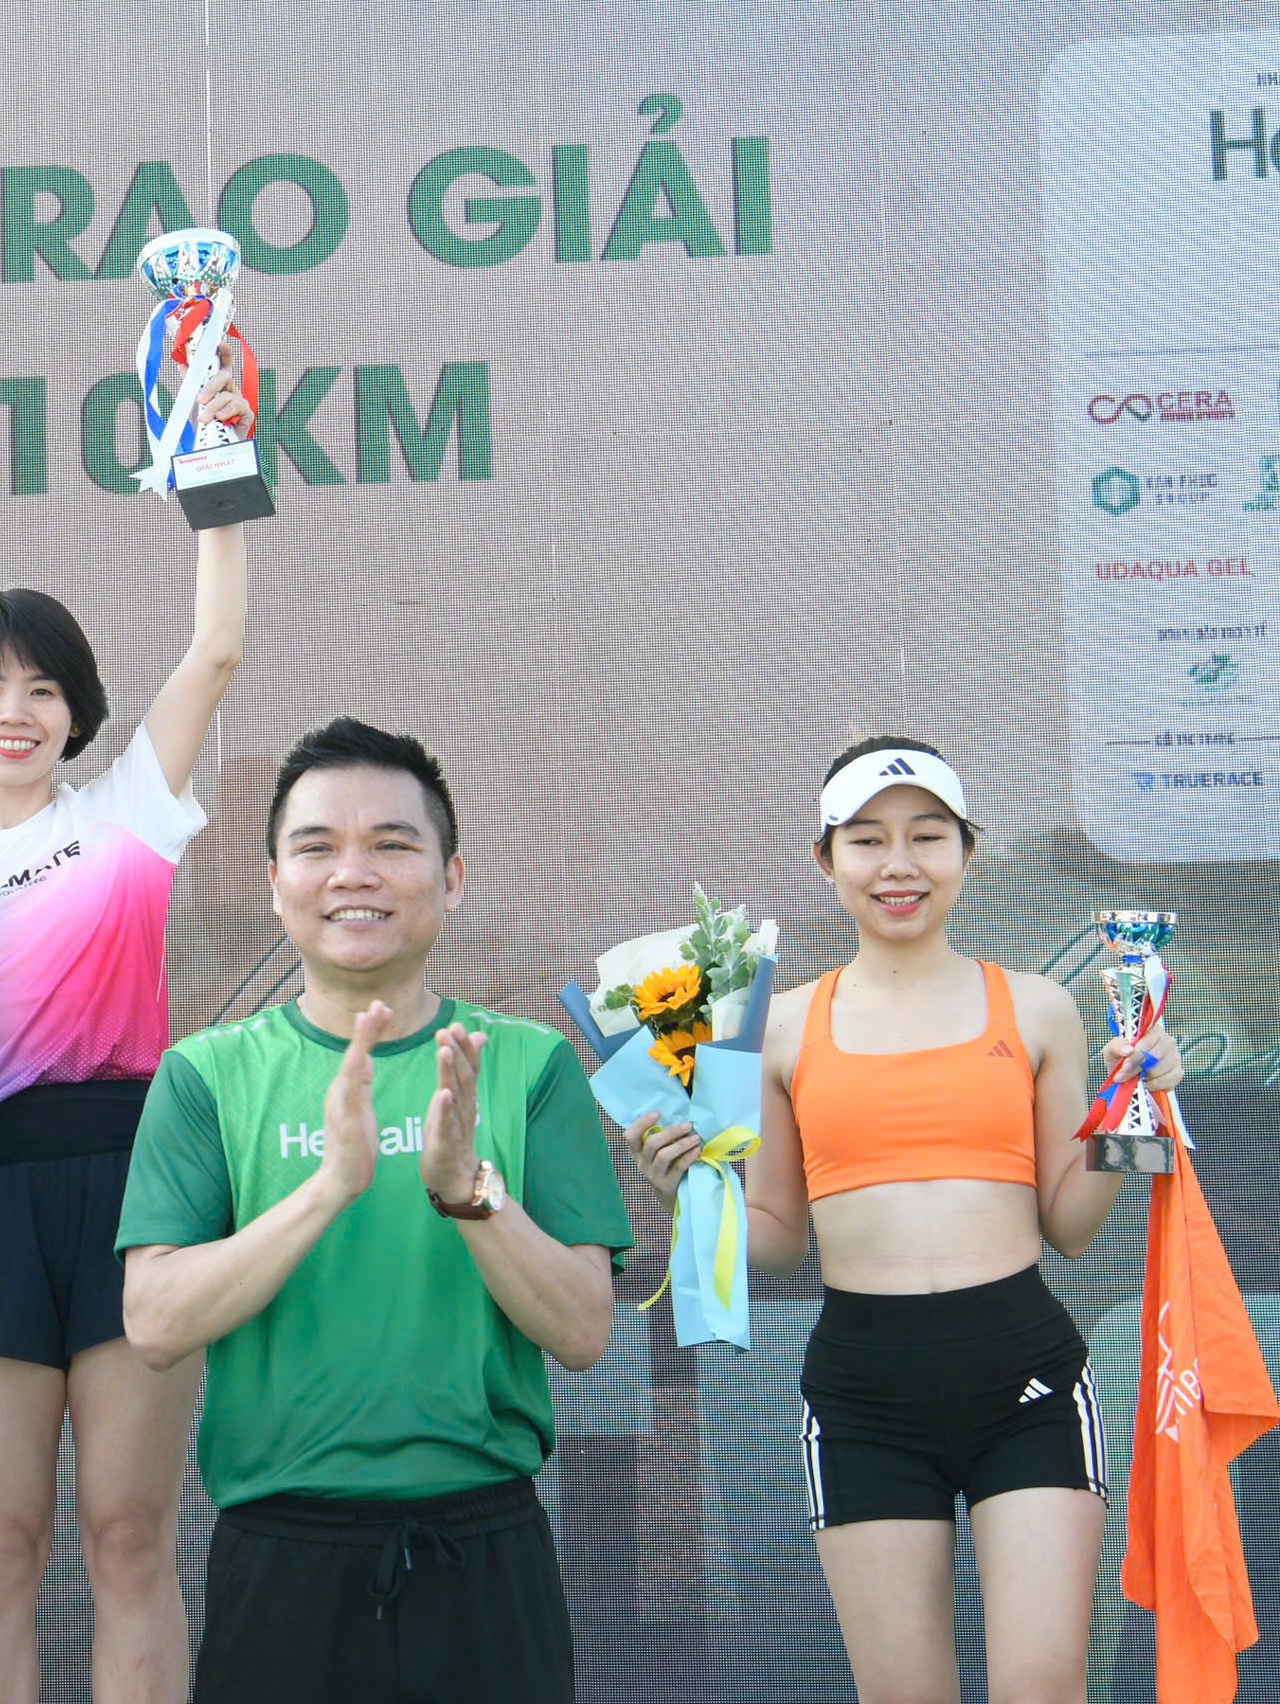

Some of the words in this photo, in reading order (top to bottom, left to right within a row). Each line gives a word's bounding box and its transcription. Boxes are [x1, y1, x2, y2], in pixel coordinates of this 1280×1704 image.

[407, 93, 774, 269] GIẢI
[258, 361, 492, 486] KM
[1095, 559, 1200, 581] UDAQUA
[1207, 556, 1255, 577] GEL
[279, 1116, 424, 1158] Heali
